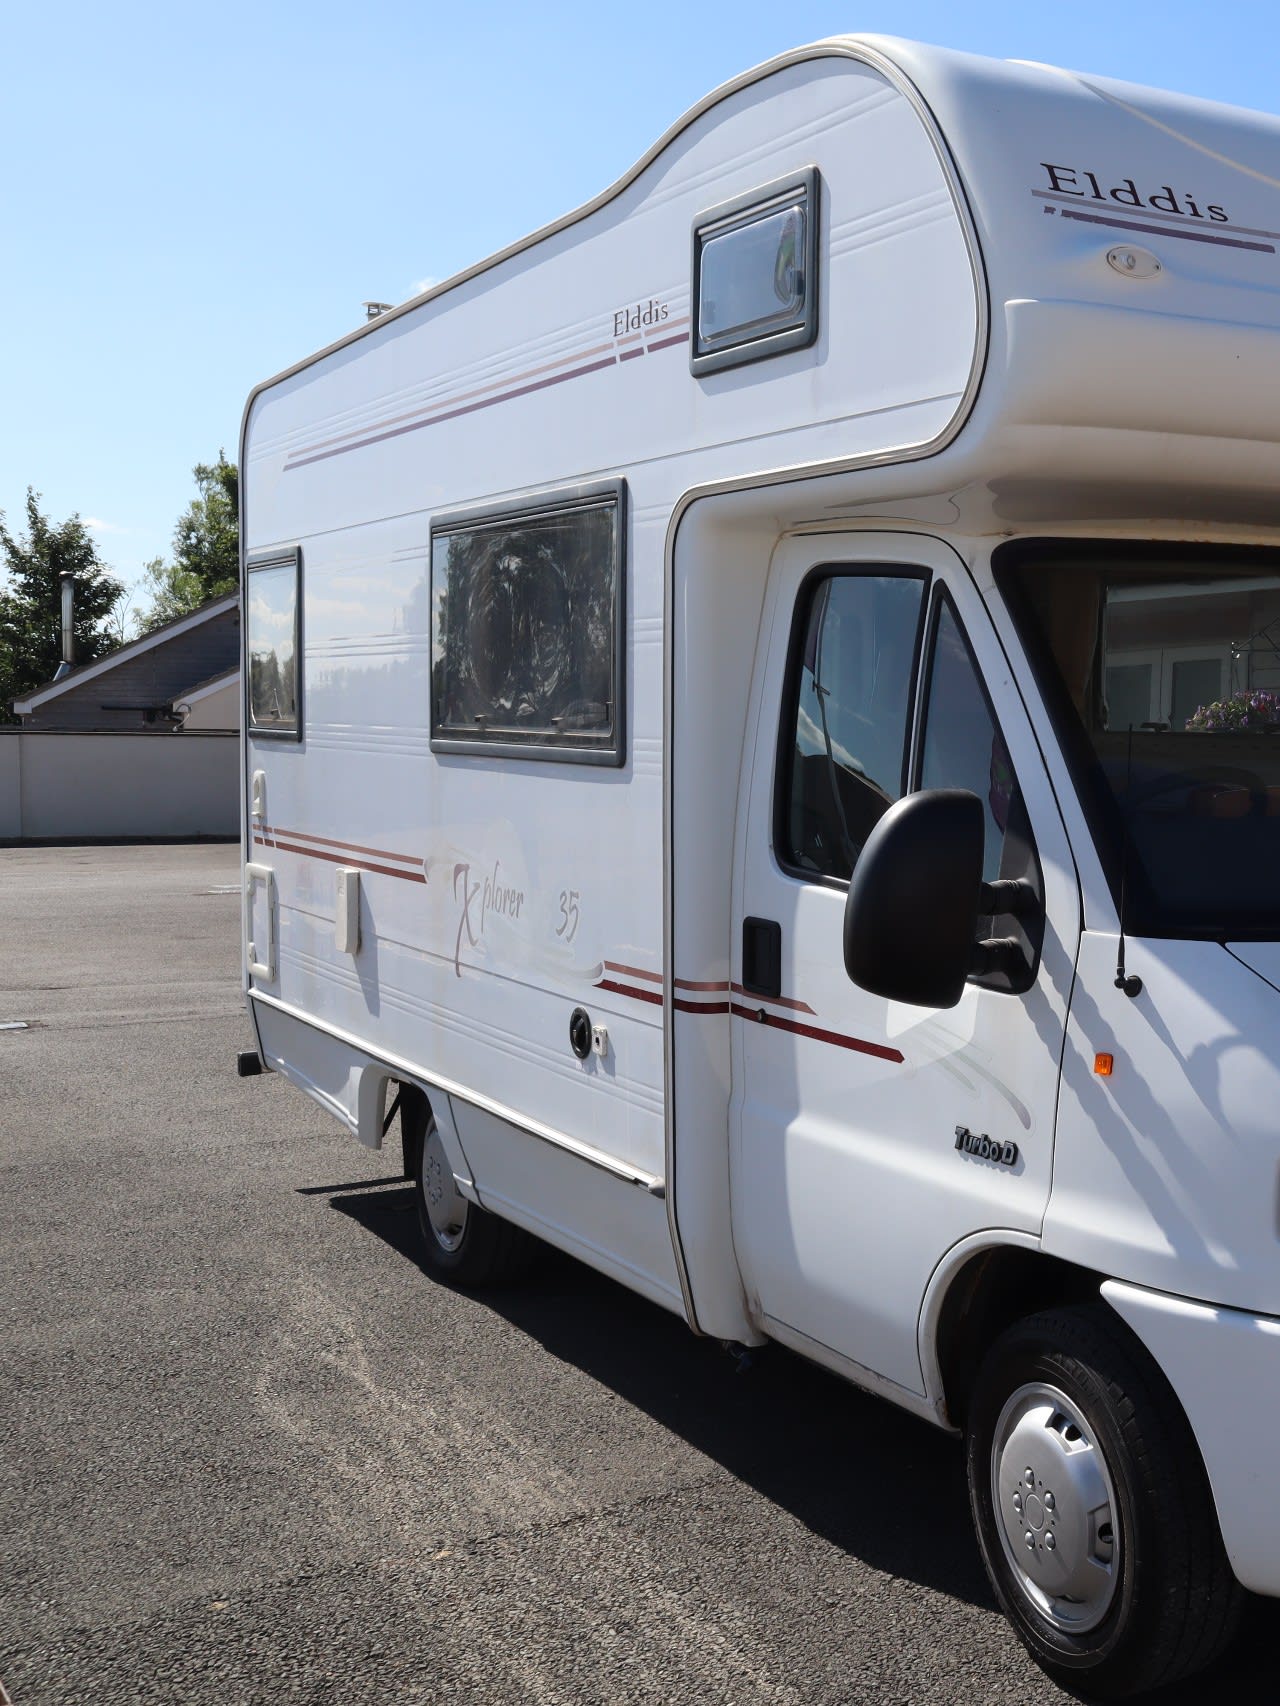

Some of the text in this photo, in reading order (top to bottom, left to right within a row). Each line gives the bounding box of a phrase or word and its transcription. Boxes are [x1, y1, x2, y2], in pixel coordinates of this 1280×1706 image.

[1040, 162, 1229, 222] Elddis
[613, 300, 669, 337] Elddis
[453, 859, 580, 978] Xplorer 35
